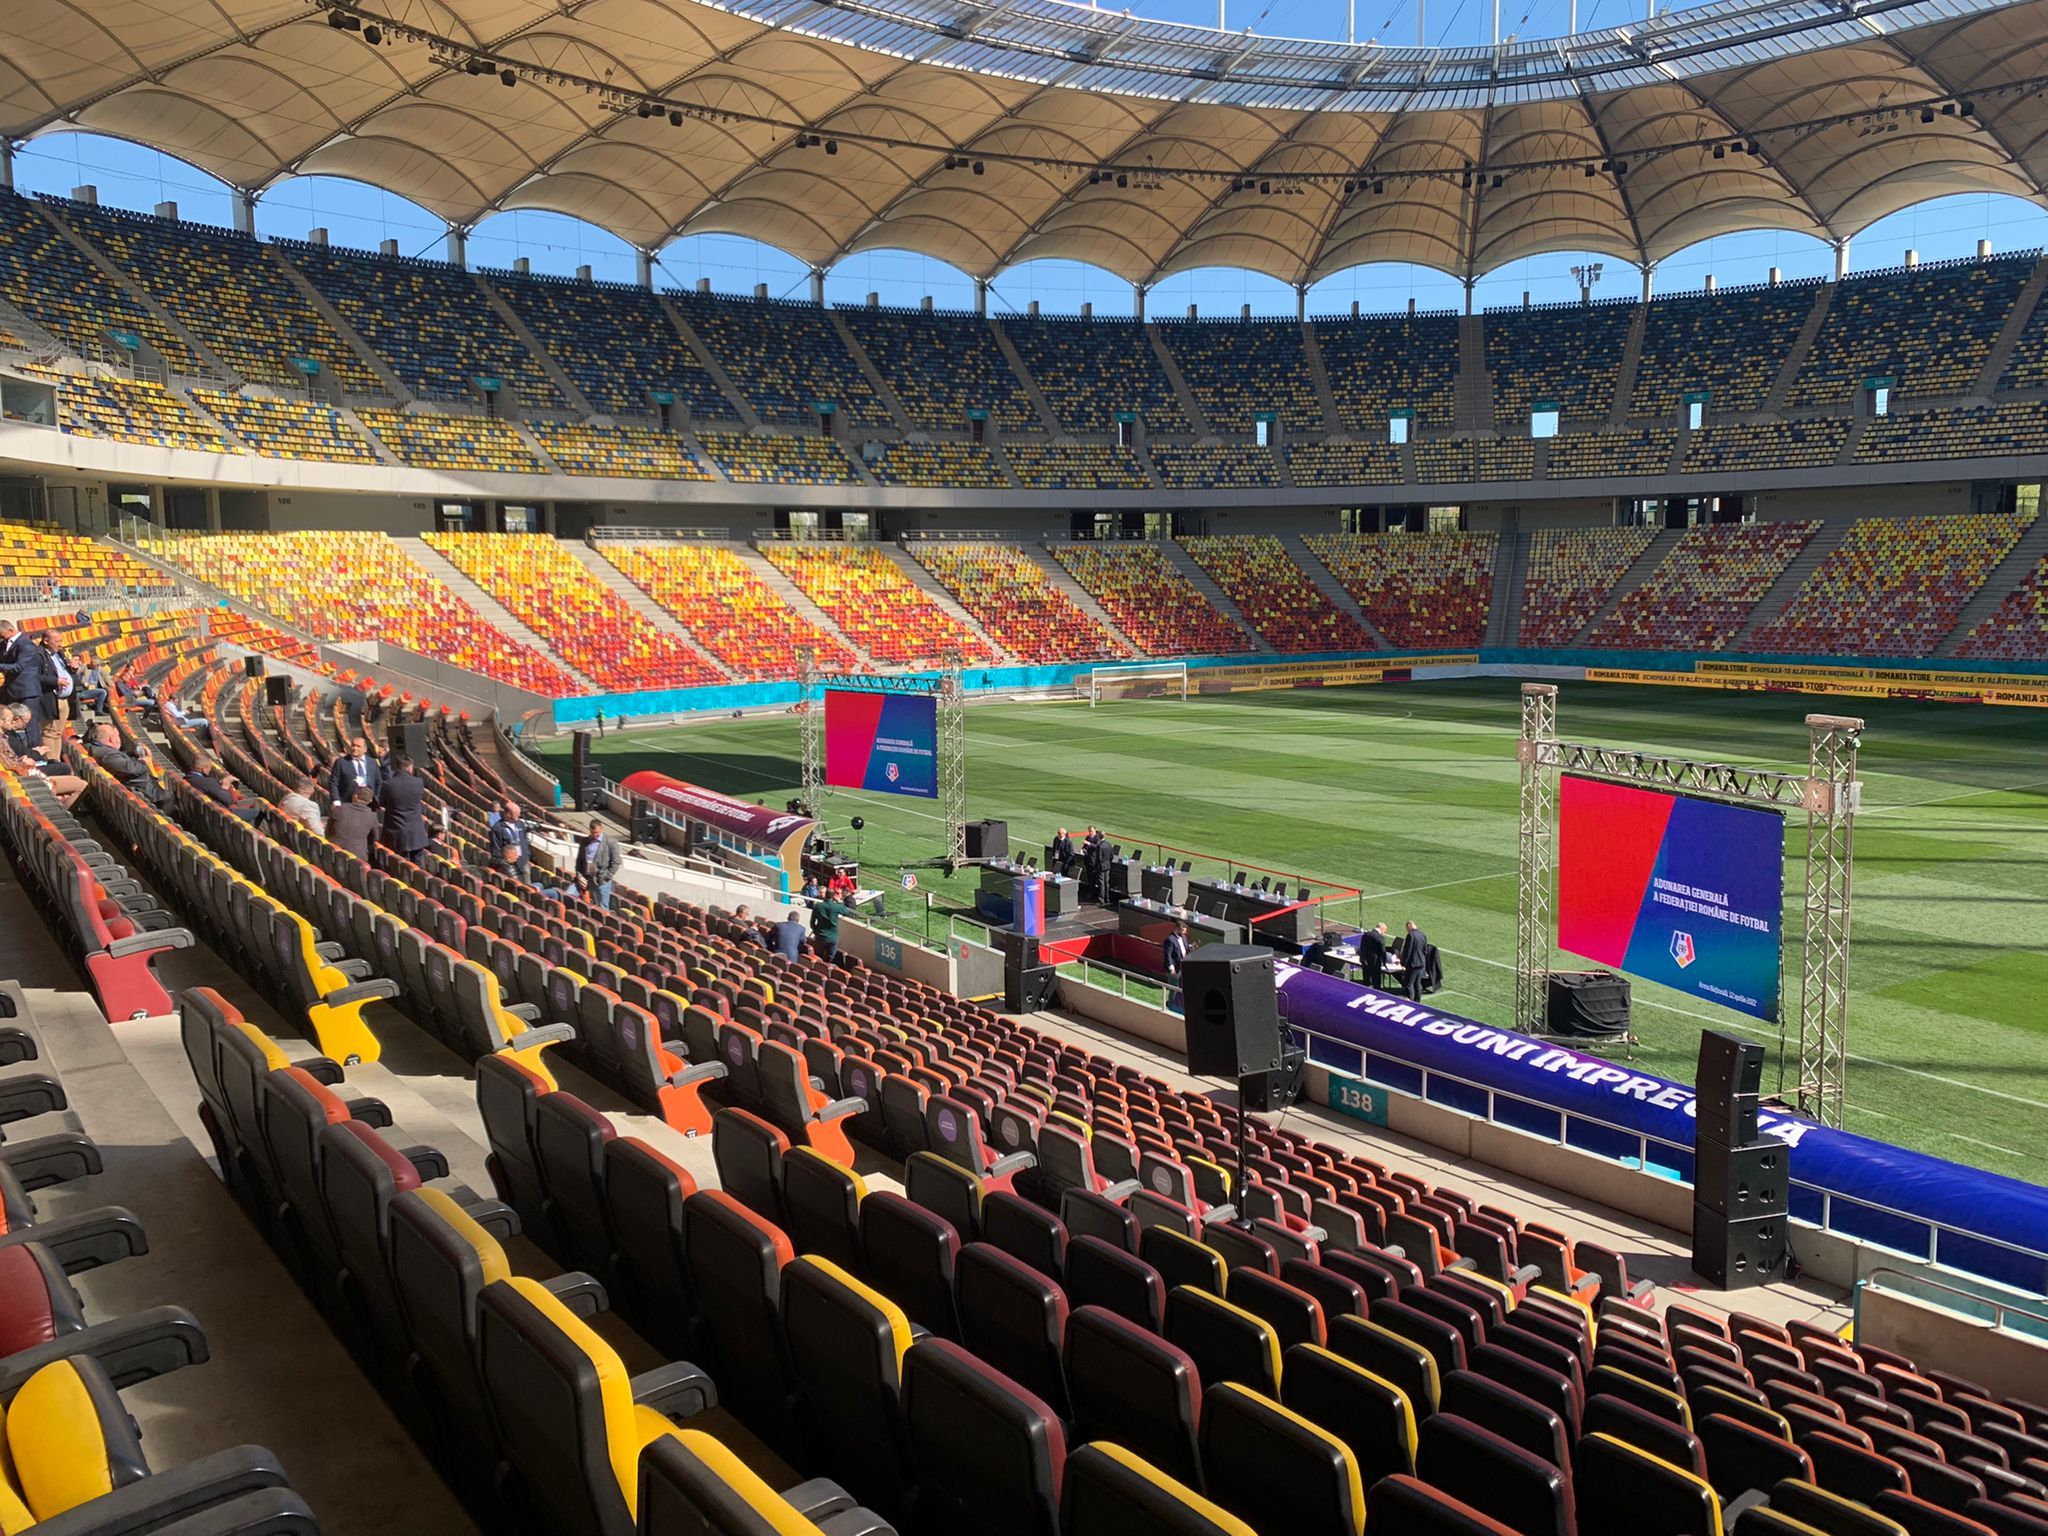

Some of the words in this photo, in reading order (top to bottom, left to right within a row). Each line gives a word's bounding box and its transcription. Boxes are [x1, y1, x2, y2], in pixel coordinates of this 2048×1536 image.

[1875, 671, 1908, 681] ROMANIA
[1909, 673, 1931, 681] STORE
[1995, 692, 2038, 702] ROMANIA
[1654, 877, 1691, 897] ADUNAREA
[1691, 887, 1728, 906] GENERALĂ
[1653, 891, 1659, 901] A
[1659, 893, 1698, 913] FEDERAȚIEI
[1698, 904, 1729, 921] ROMÂNE
[1729, 911, 1740, 925] DE
[1740, 914, 1769, 932] FOTBAL
[880, 943, 896, 960] 136
[1347, 993, 1430, 1027] MAI
[1421, 1017, 1541, 1061] BUNI
[1341, 1087, 1373, 1113] 138
